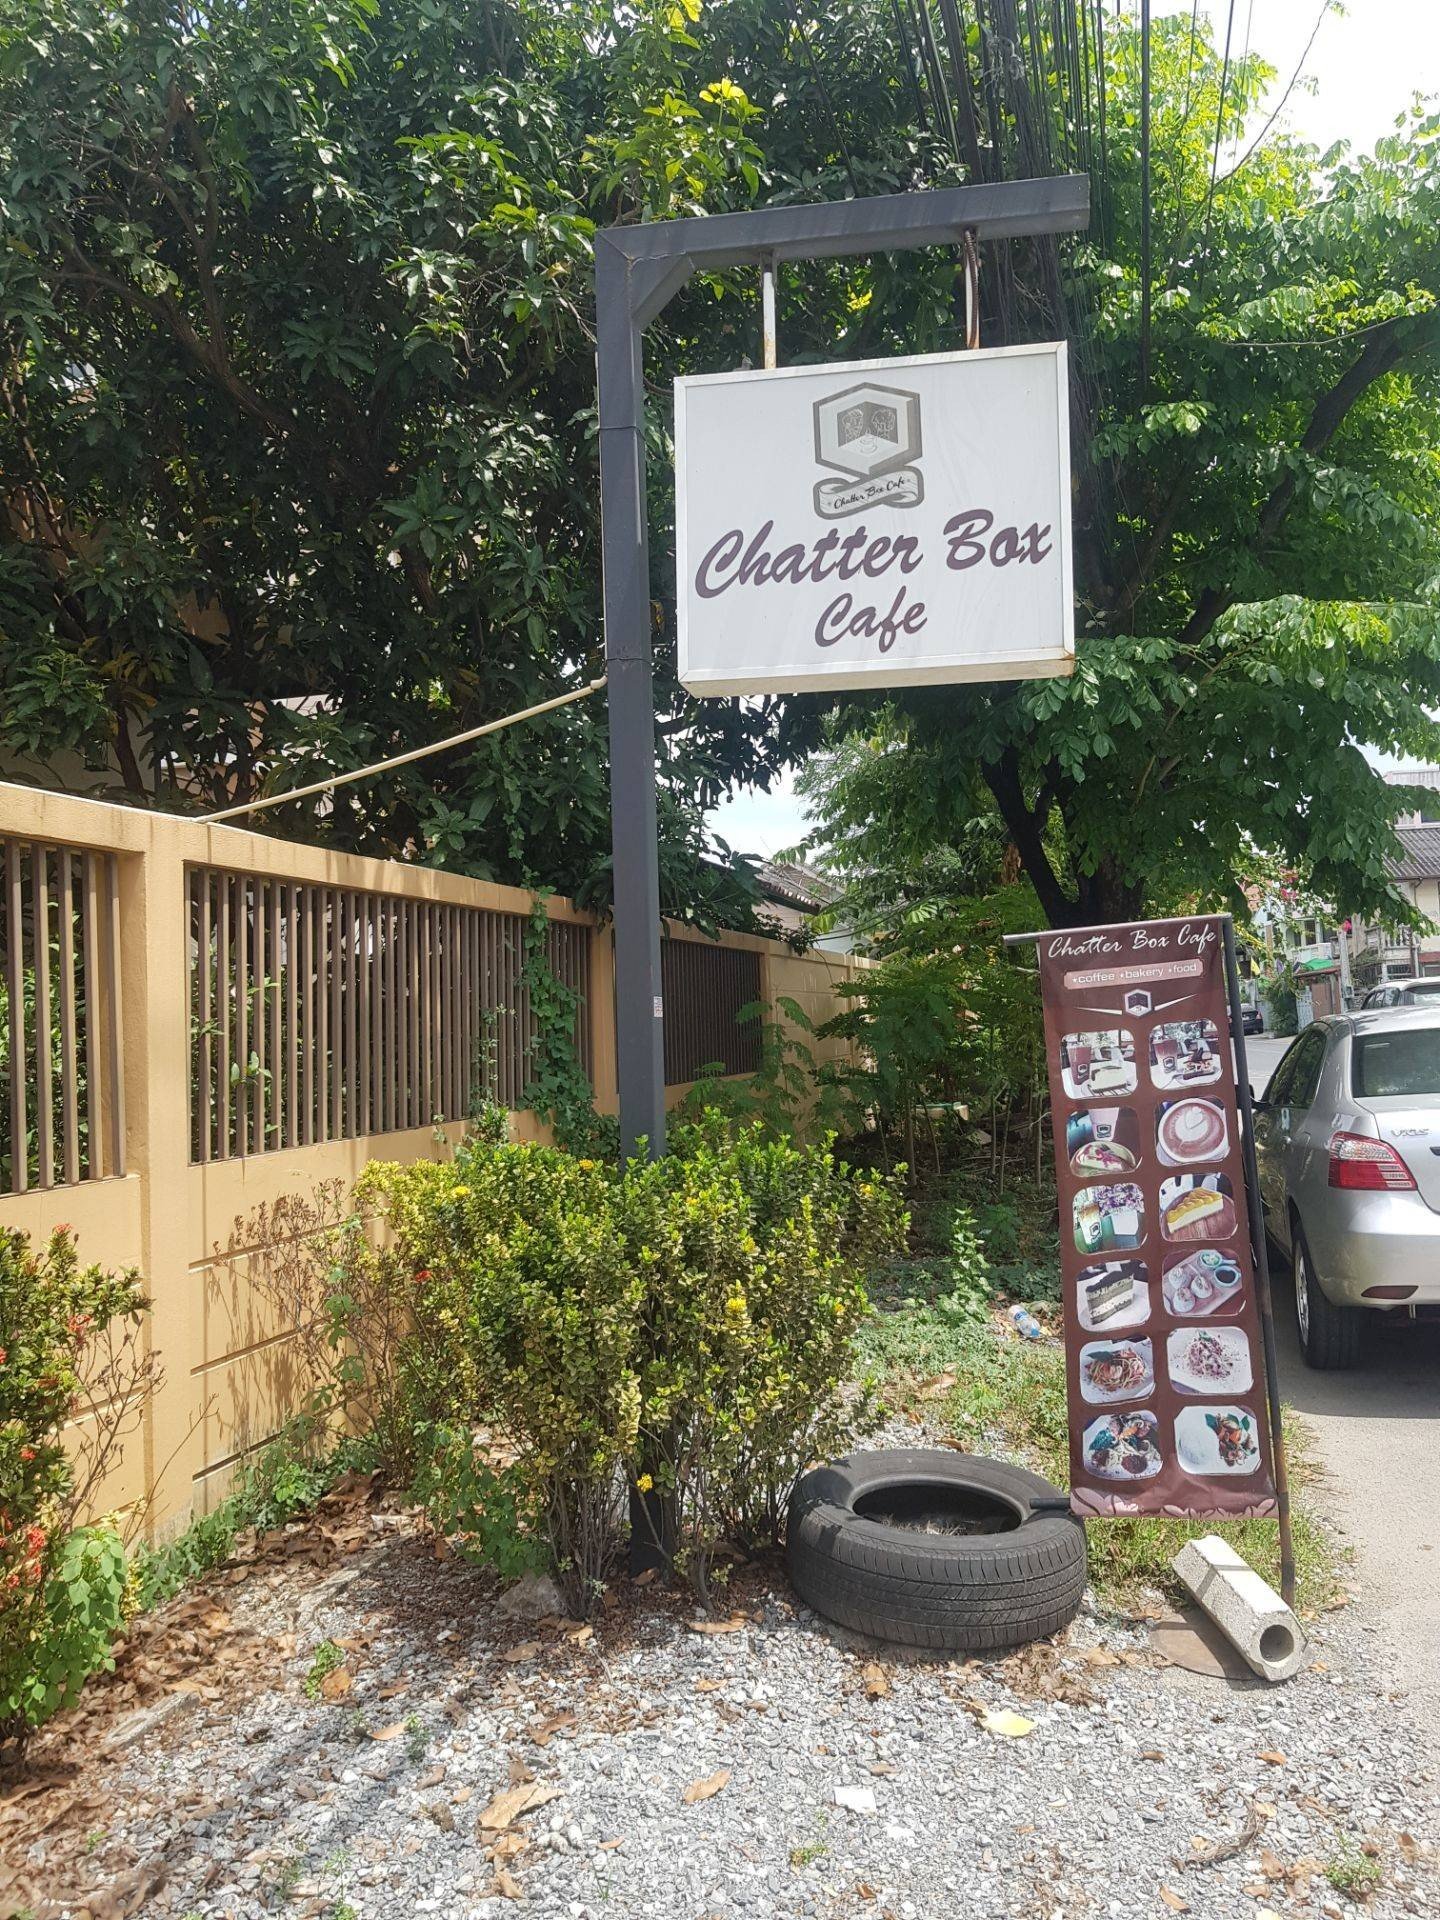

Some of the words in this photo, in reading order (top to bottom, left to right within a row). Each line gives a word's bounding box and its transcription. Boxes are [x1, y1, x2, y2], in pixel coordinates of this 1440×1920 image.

[834, 493, 865, 509] Chatter
[695, 520, 923, 599] Chatter
[943, 509, 1053, 571] Box
[814, 586, 928, 653] Cafe
[1048, 936, 1122, 958] Chatter
[1130, 929, 1170, 950] Box
[1177, 923, 1216, 954] Cafe
